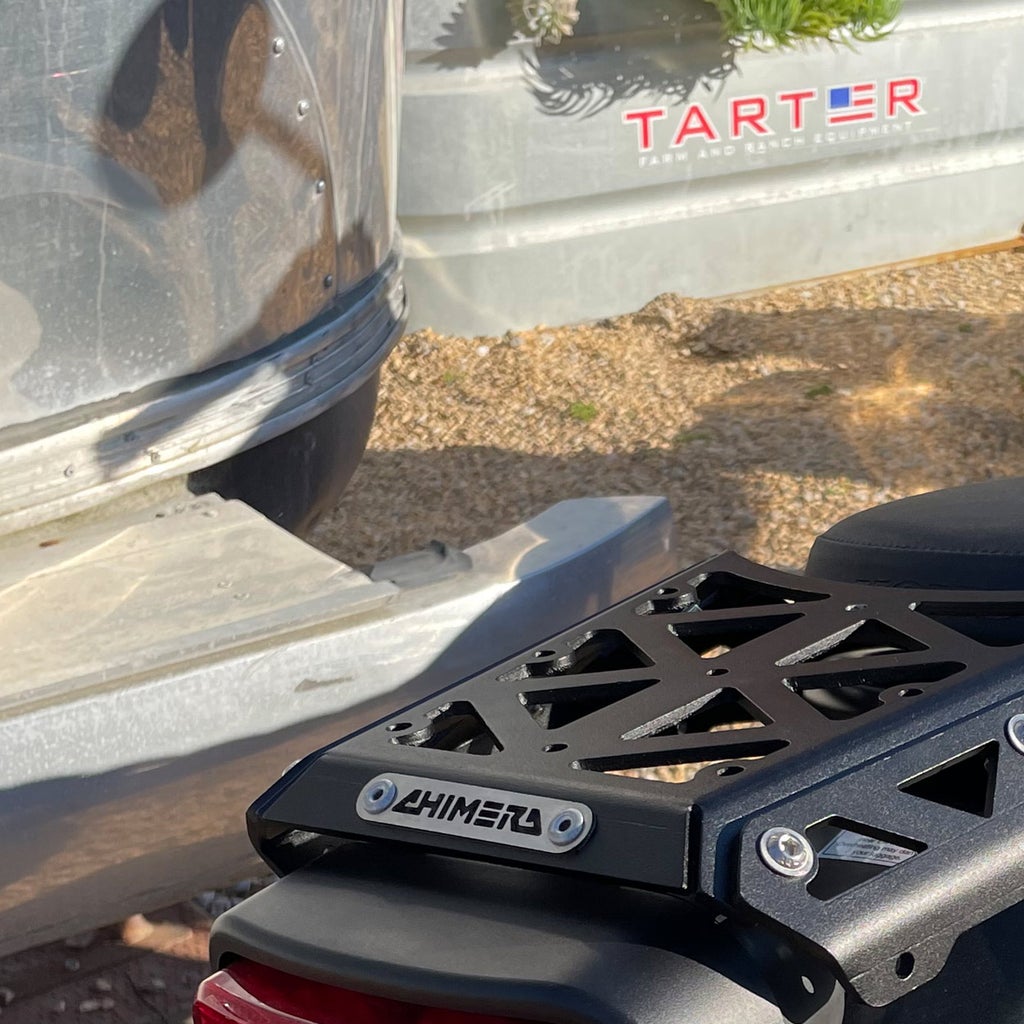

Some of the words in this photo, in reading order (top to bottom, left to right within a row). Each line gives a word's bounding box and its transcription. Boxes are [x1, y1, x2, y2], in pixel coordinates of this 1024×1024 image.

[622, 77, 926, 152] TARTER
[638, 153, 689, 167] FARM
[697, 145, 736, 159] AND
[744, 134, 806, 155] RANCH
[814, 121, 913, 144] EQUIPMENT
